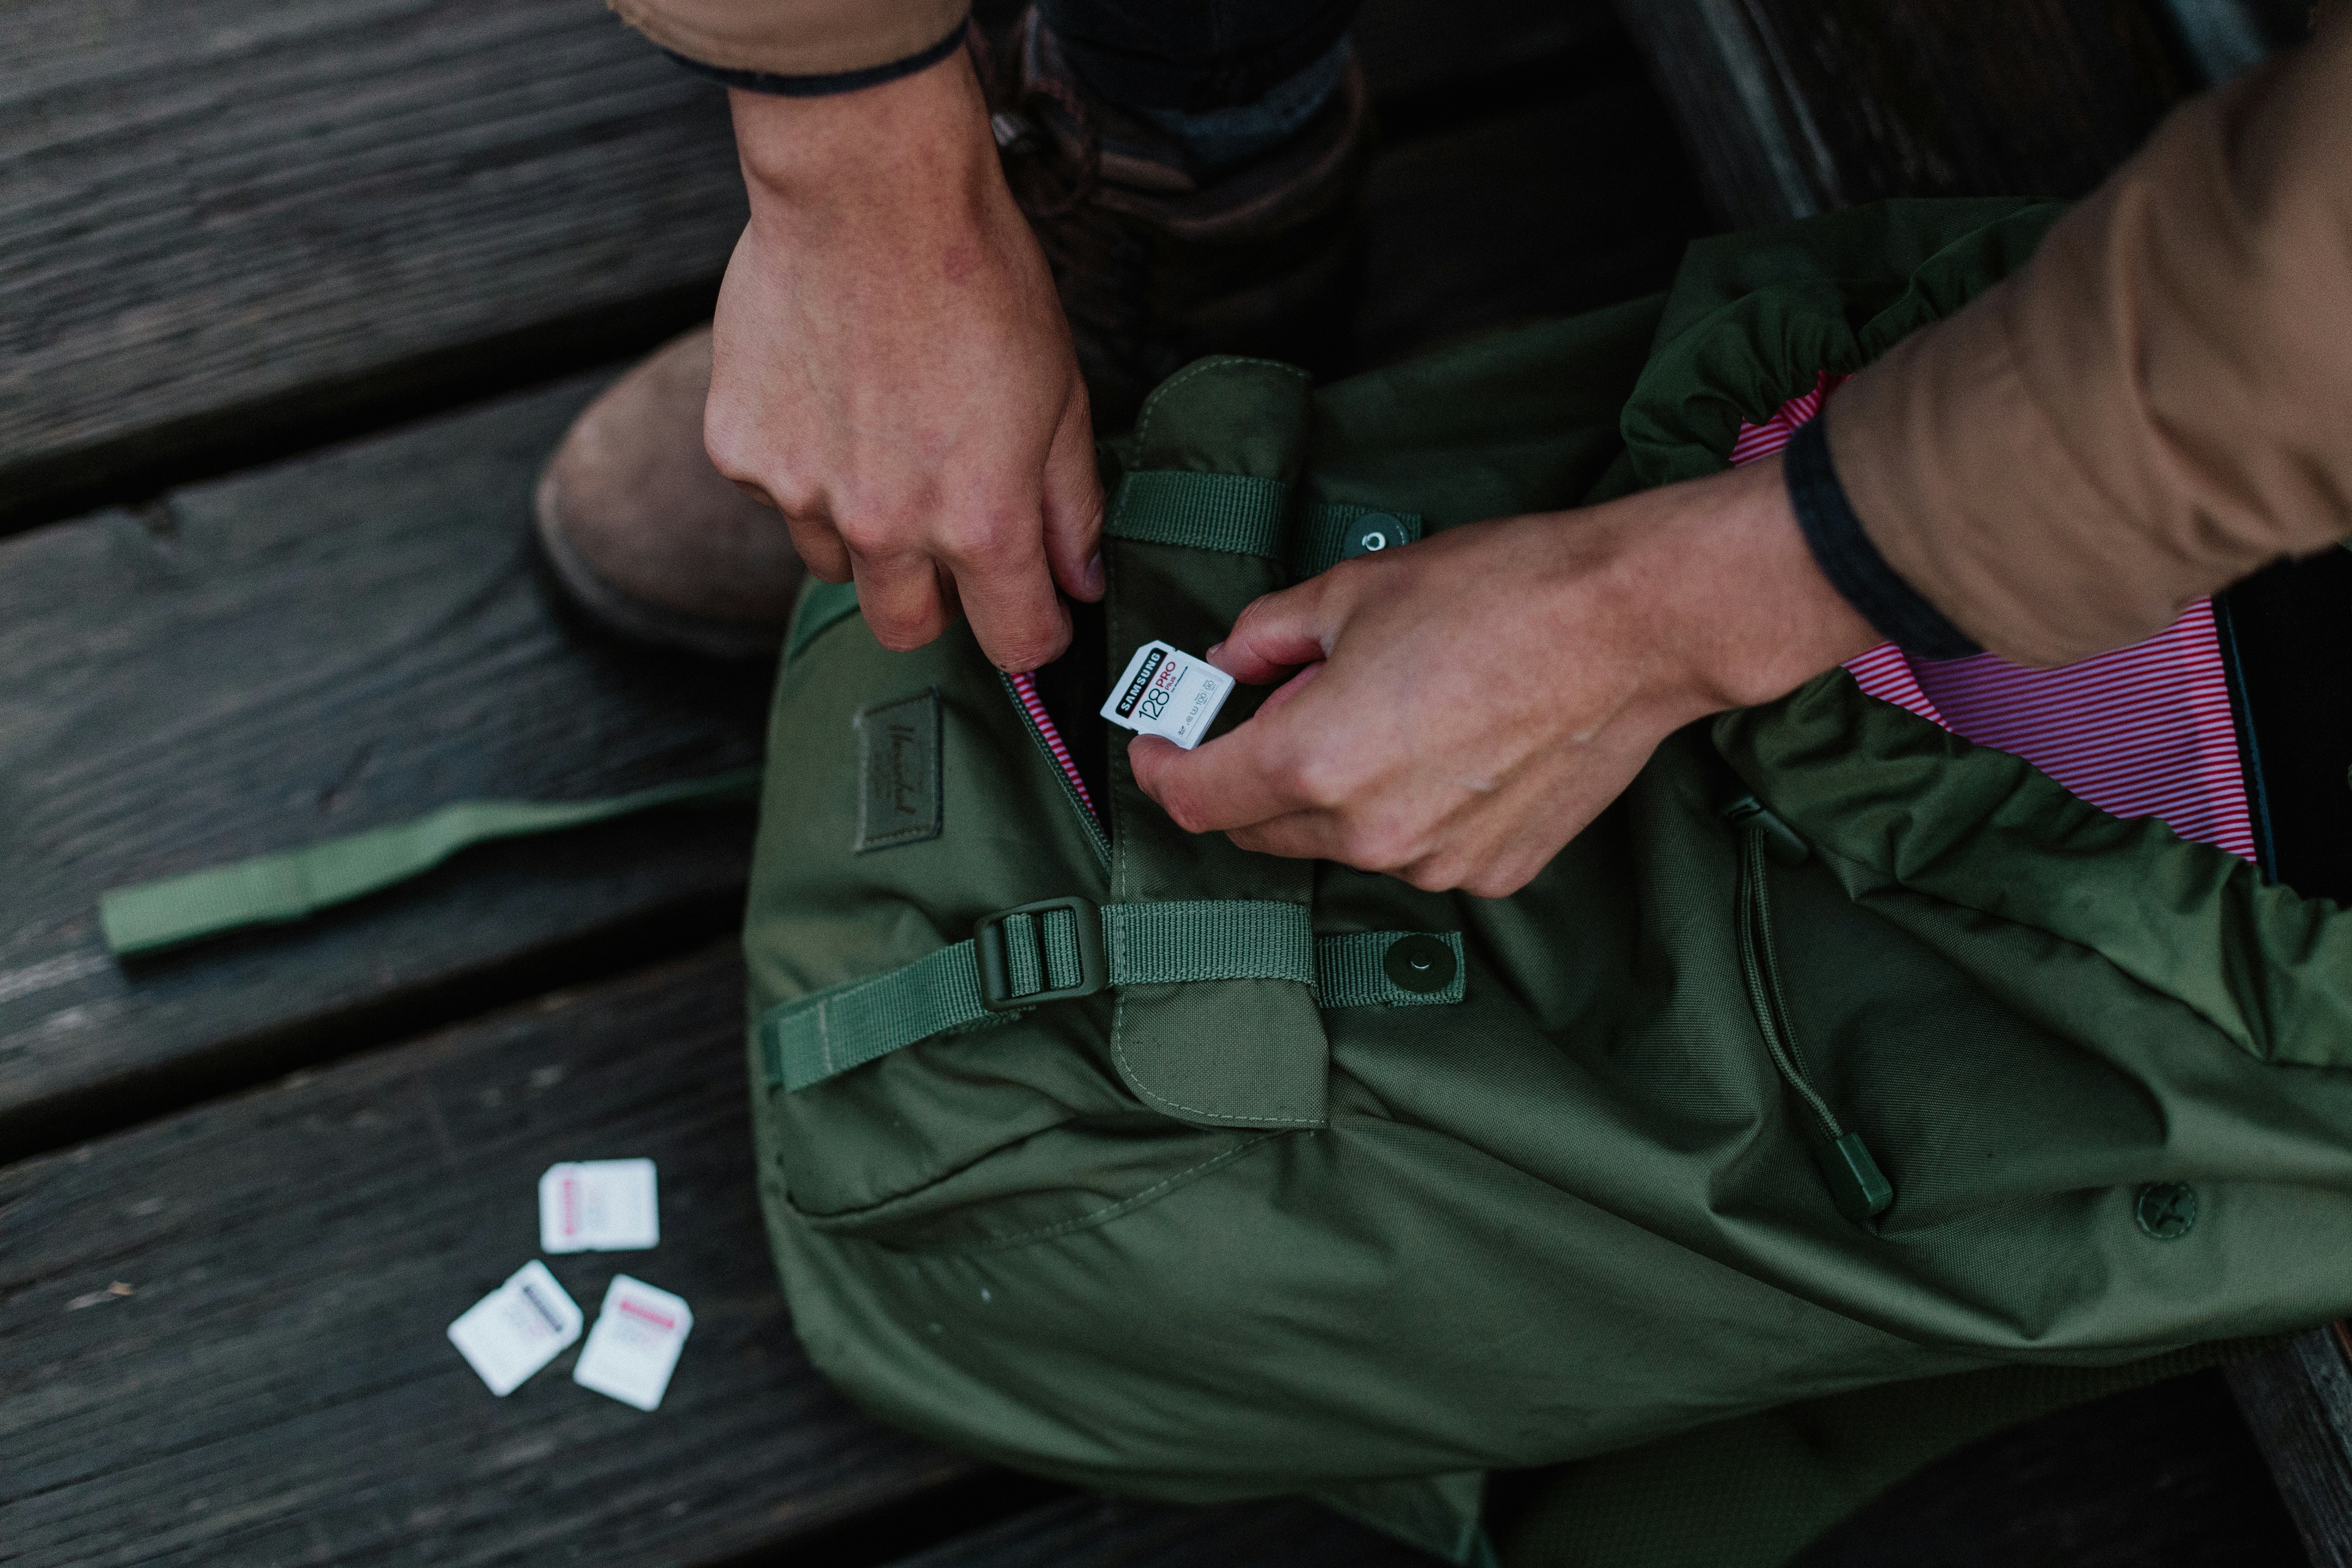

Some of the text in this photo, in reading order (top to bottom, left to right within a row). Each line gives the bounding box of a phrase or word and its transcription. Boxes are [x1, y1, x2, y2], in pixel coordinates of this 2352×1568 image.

[1120, 652, 1161, 711] SAMSUNG
[1155, 661, 1176, 688] PRO
[1164, 676, 1176, 690] Plus
[1138, 688, 1170, 720] 128
[1196, 692, 1207, 705] 100
[1204, 680, 1214, 691] 90
